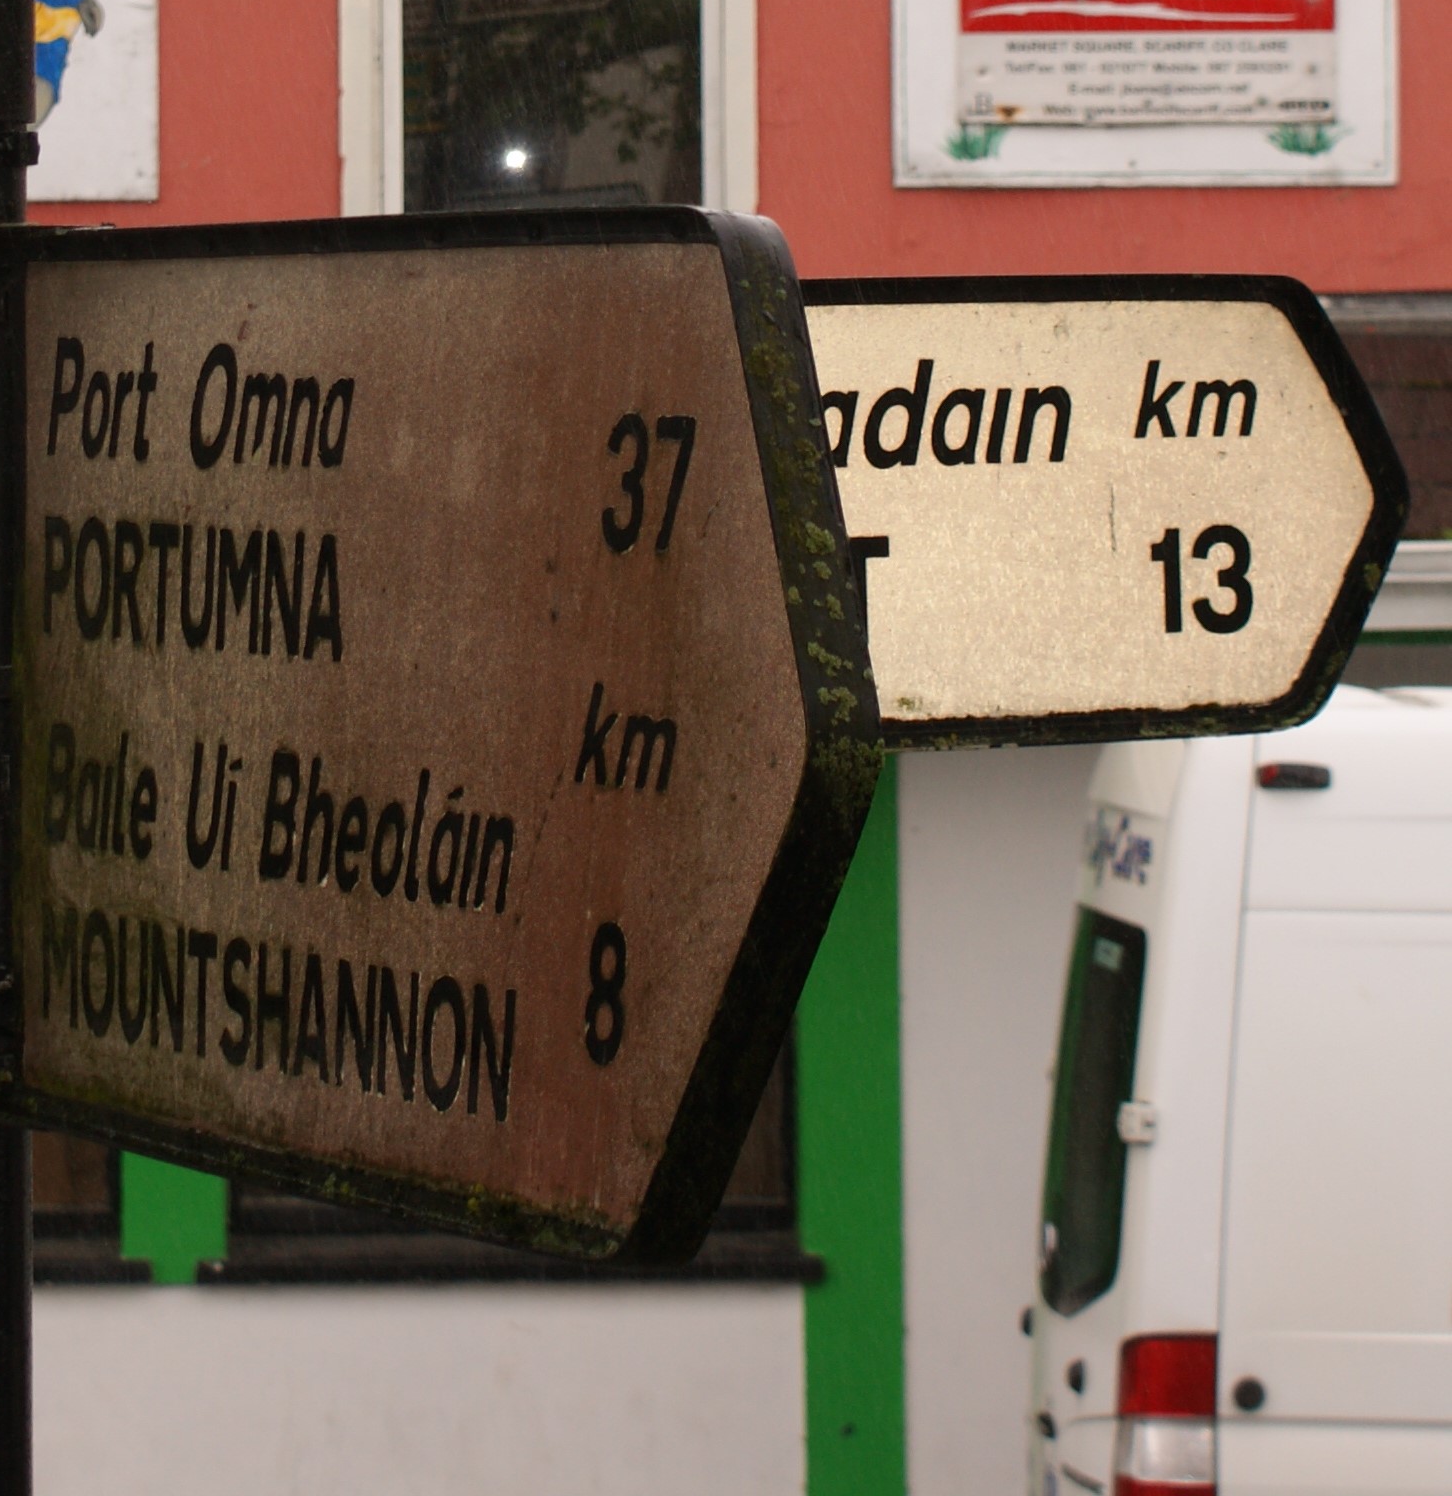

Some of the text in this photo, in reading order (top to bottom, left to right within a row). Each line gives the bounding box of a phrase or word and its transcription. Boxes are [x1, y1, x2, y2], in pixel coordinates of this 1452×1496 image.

[47, 336, 696, 555] Port Omna 37
[821, 358, 1259, 469] adain km
[42, 514, 344, 664] PORTUMNA
[1151, 524, 1254, 634] 13
[574, 682, 678, 793] km
[44, 722, 516, 915] Baile Uí Bheoláin
[41, 907, 516, 1124] MOUNTSHANNON
[584, 921, 628, 1066] 8
